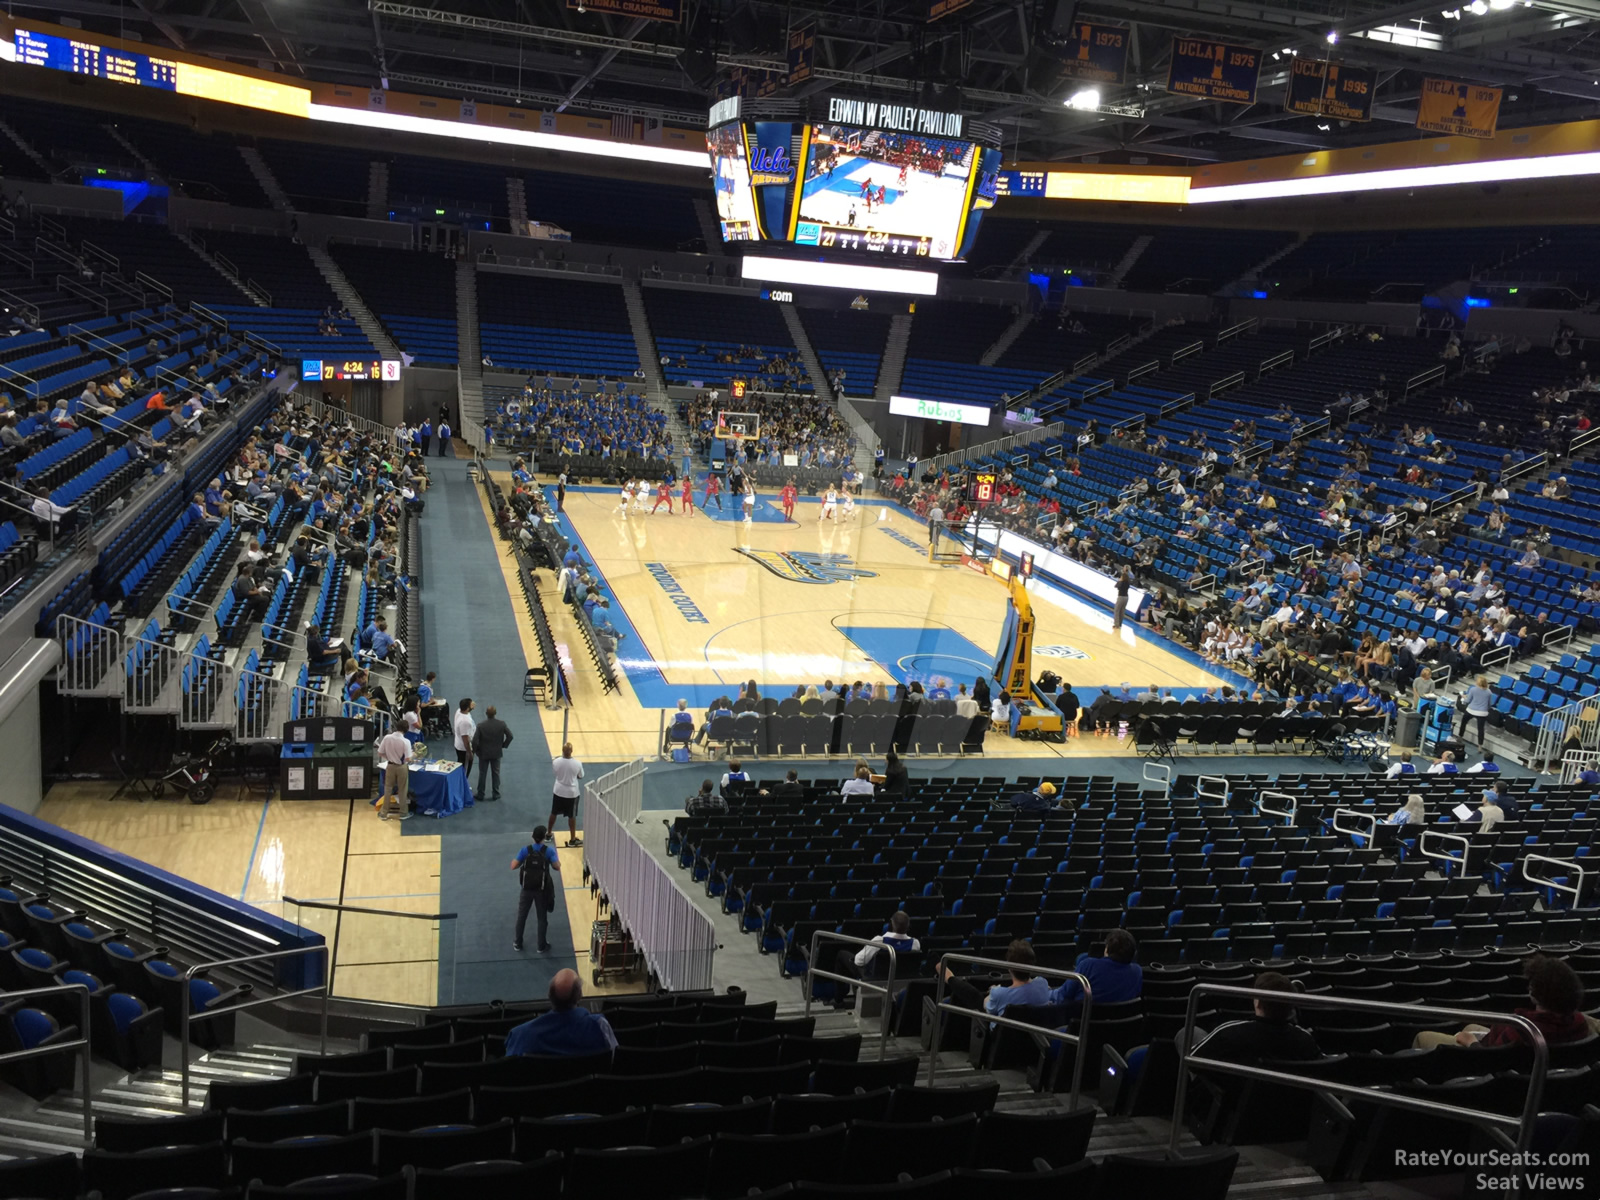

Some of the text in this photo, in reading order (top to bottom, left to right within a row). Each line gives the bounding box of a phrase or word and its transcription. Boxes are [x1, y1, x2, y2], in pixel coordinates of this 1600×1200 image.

[623, 2, 674, 17] CHAMPIONS
[1095, 32, 1123, 48] 1973
[1179, 42, 1213, 59] UCLA
[1230, 53, 1255, 68] 1975
[1294, 61, 1326, 78] UCLA
[1343, 80, 1368, 94] 1995
[1174, 81, 1249, 99] NATIONAL CHAMPIONS
[1426, 81, 1455, 96] UCLA
[829, 97, 962, 137] EDWIN W PAULEY PAVILION
[1421, 121, 1492, 137] NATIONAL CHAMPIONS
[822, 231, 837, 247] 27
[863, 231, 890, 244] 4:24
[916, 241, 928, 256] 15
[841, 239, 858, 249] 2 4
[325, 366, 334, 379] 27
[343, 362, 363, 373] 4:24
[371, 366, 380, 379] 15
[977, 475, 995, 484] 4:24
[978, 484, 990, 499] 18
[644, 562, 685, 593] WOODEN
[669, 594, 710, 624] COURT
